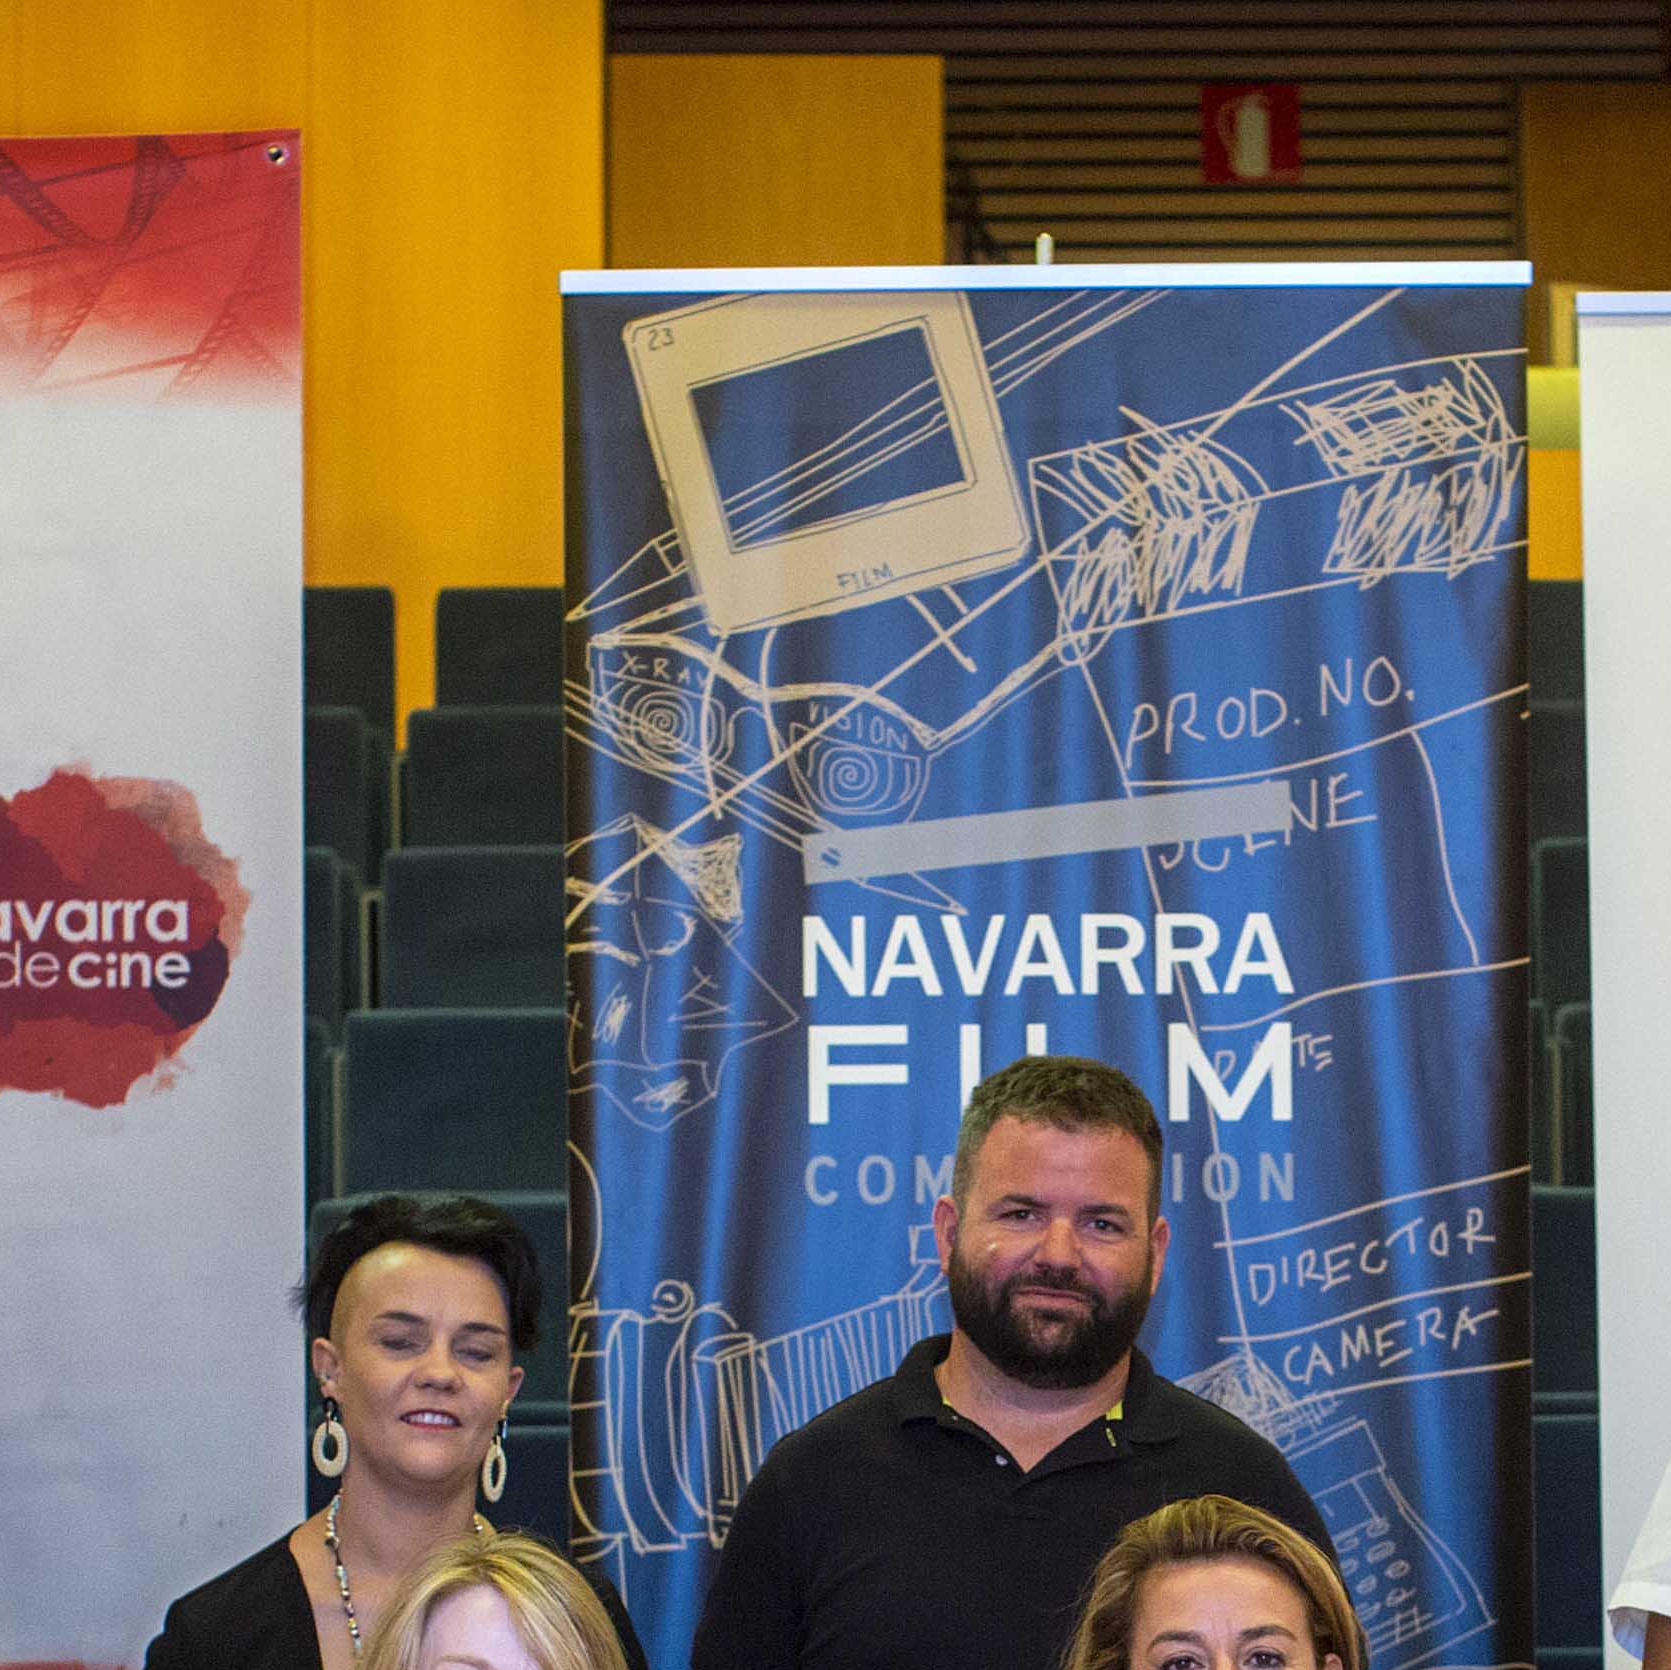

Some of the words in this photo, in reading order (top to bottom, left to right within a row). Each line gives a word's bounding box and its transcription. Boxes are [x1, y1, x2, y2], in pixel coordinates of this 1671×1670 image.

[648, 326, 676, 353] 23
[837, 562, 893, 591] FILM
[808, 703, 908, 751] VISION
[1125, 687, 1302, 770] PROD.
[1320, 656, 1415, 717] NO.
[68, 951, 192, 989] cine
[802, 912, 1296, 998] NAVARRA
[808, 1021, 1294, 1126] FIM
[804, 1151, 1296, 1206] COMION
[1248, 1207, 1496, 1306] DIRECTOR
[1284, 1306, 1499, 1385] CAMERA
